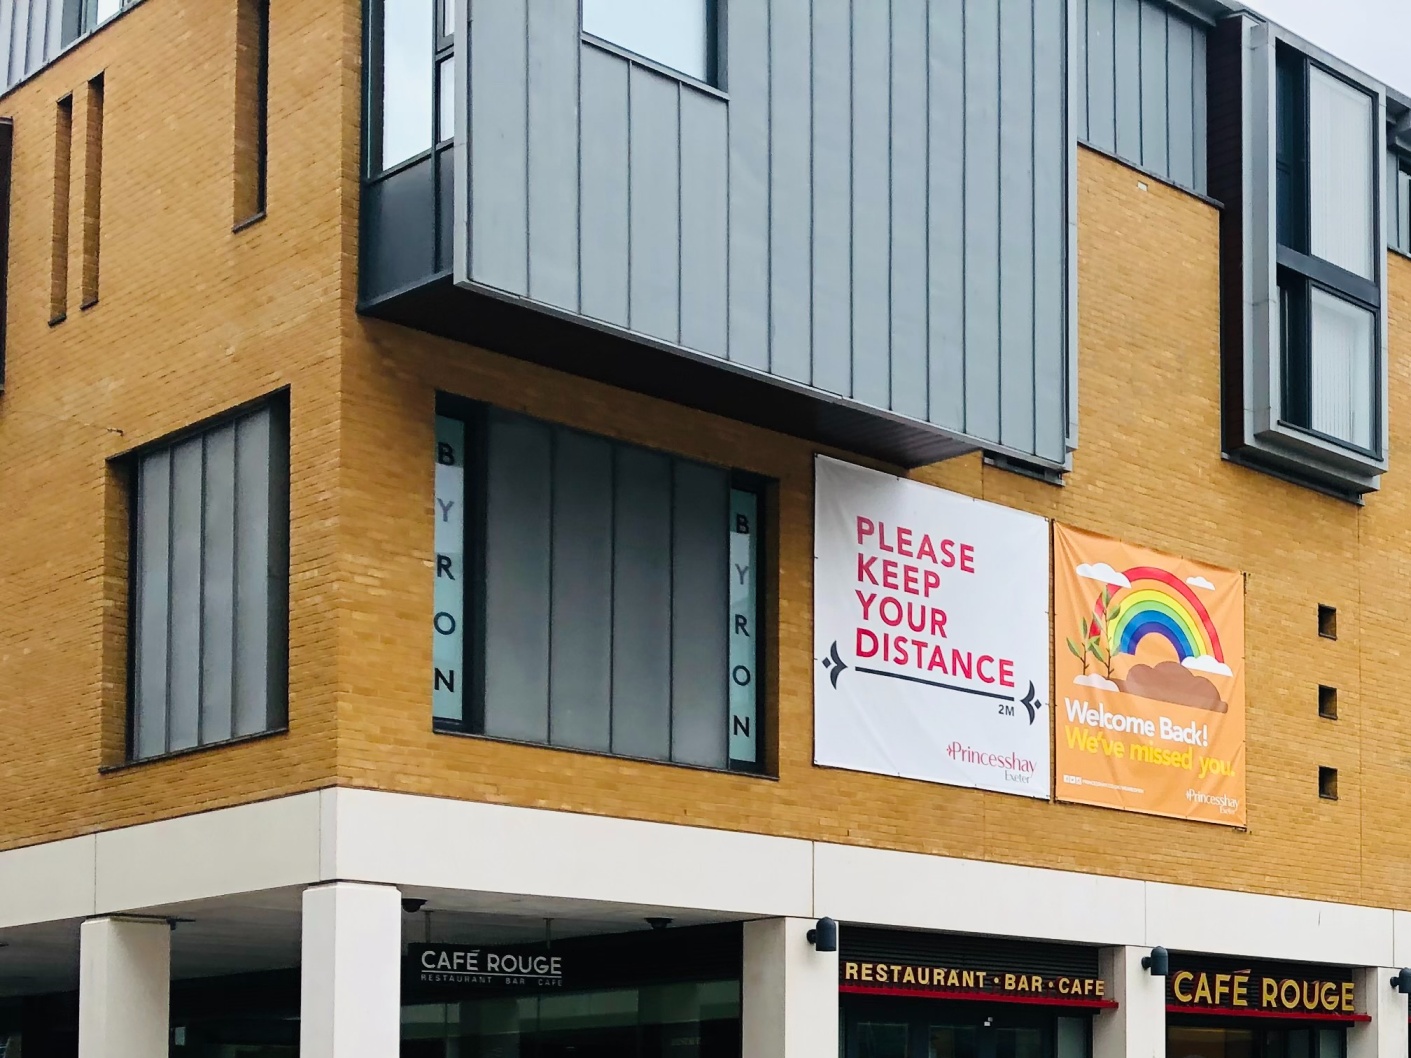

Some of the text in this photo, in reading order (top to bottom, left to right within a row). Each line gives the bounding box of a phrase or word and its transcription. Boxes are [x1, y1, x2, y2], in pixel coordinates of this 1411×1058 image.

[856, 515, 975, 574] PLEASE
[433, 442, 456, 693] BYRON
[857, 553, 941, 598] KEEP
[732, 513, 751, 738] BYRON
[855, 590, 948, 639] YOUR
[856, 628, 1015, 688] DISTANCE
[998, 704, 1015, 717] 2M
[1064, 697, 1209, 747] Welcome Back!
[950, 741, 1037, 778] Princesshay
[1064, 725, 1236, 779] We've missed you.
[1004, 769, 1031, 784] Exeter
[1187, 788, 1239, 811] Princesshay
[420, 973, 492, 984] RESTAURANT
[505, 977, 525, 985] BAR
[421, 949, 562, 975] CAFÉ ROUGE
[845, 962, 1105, 996] RESTAURANT BAR CAFE
[1173, 969, 1355, 1012] CAFÉ ROUGE
